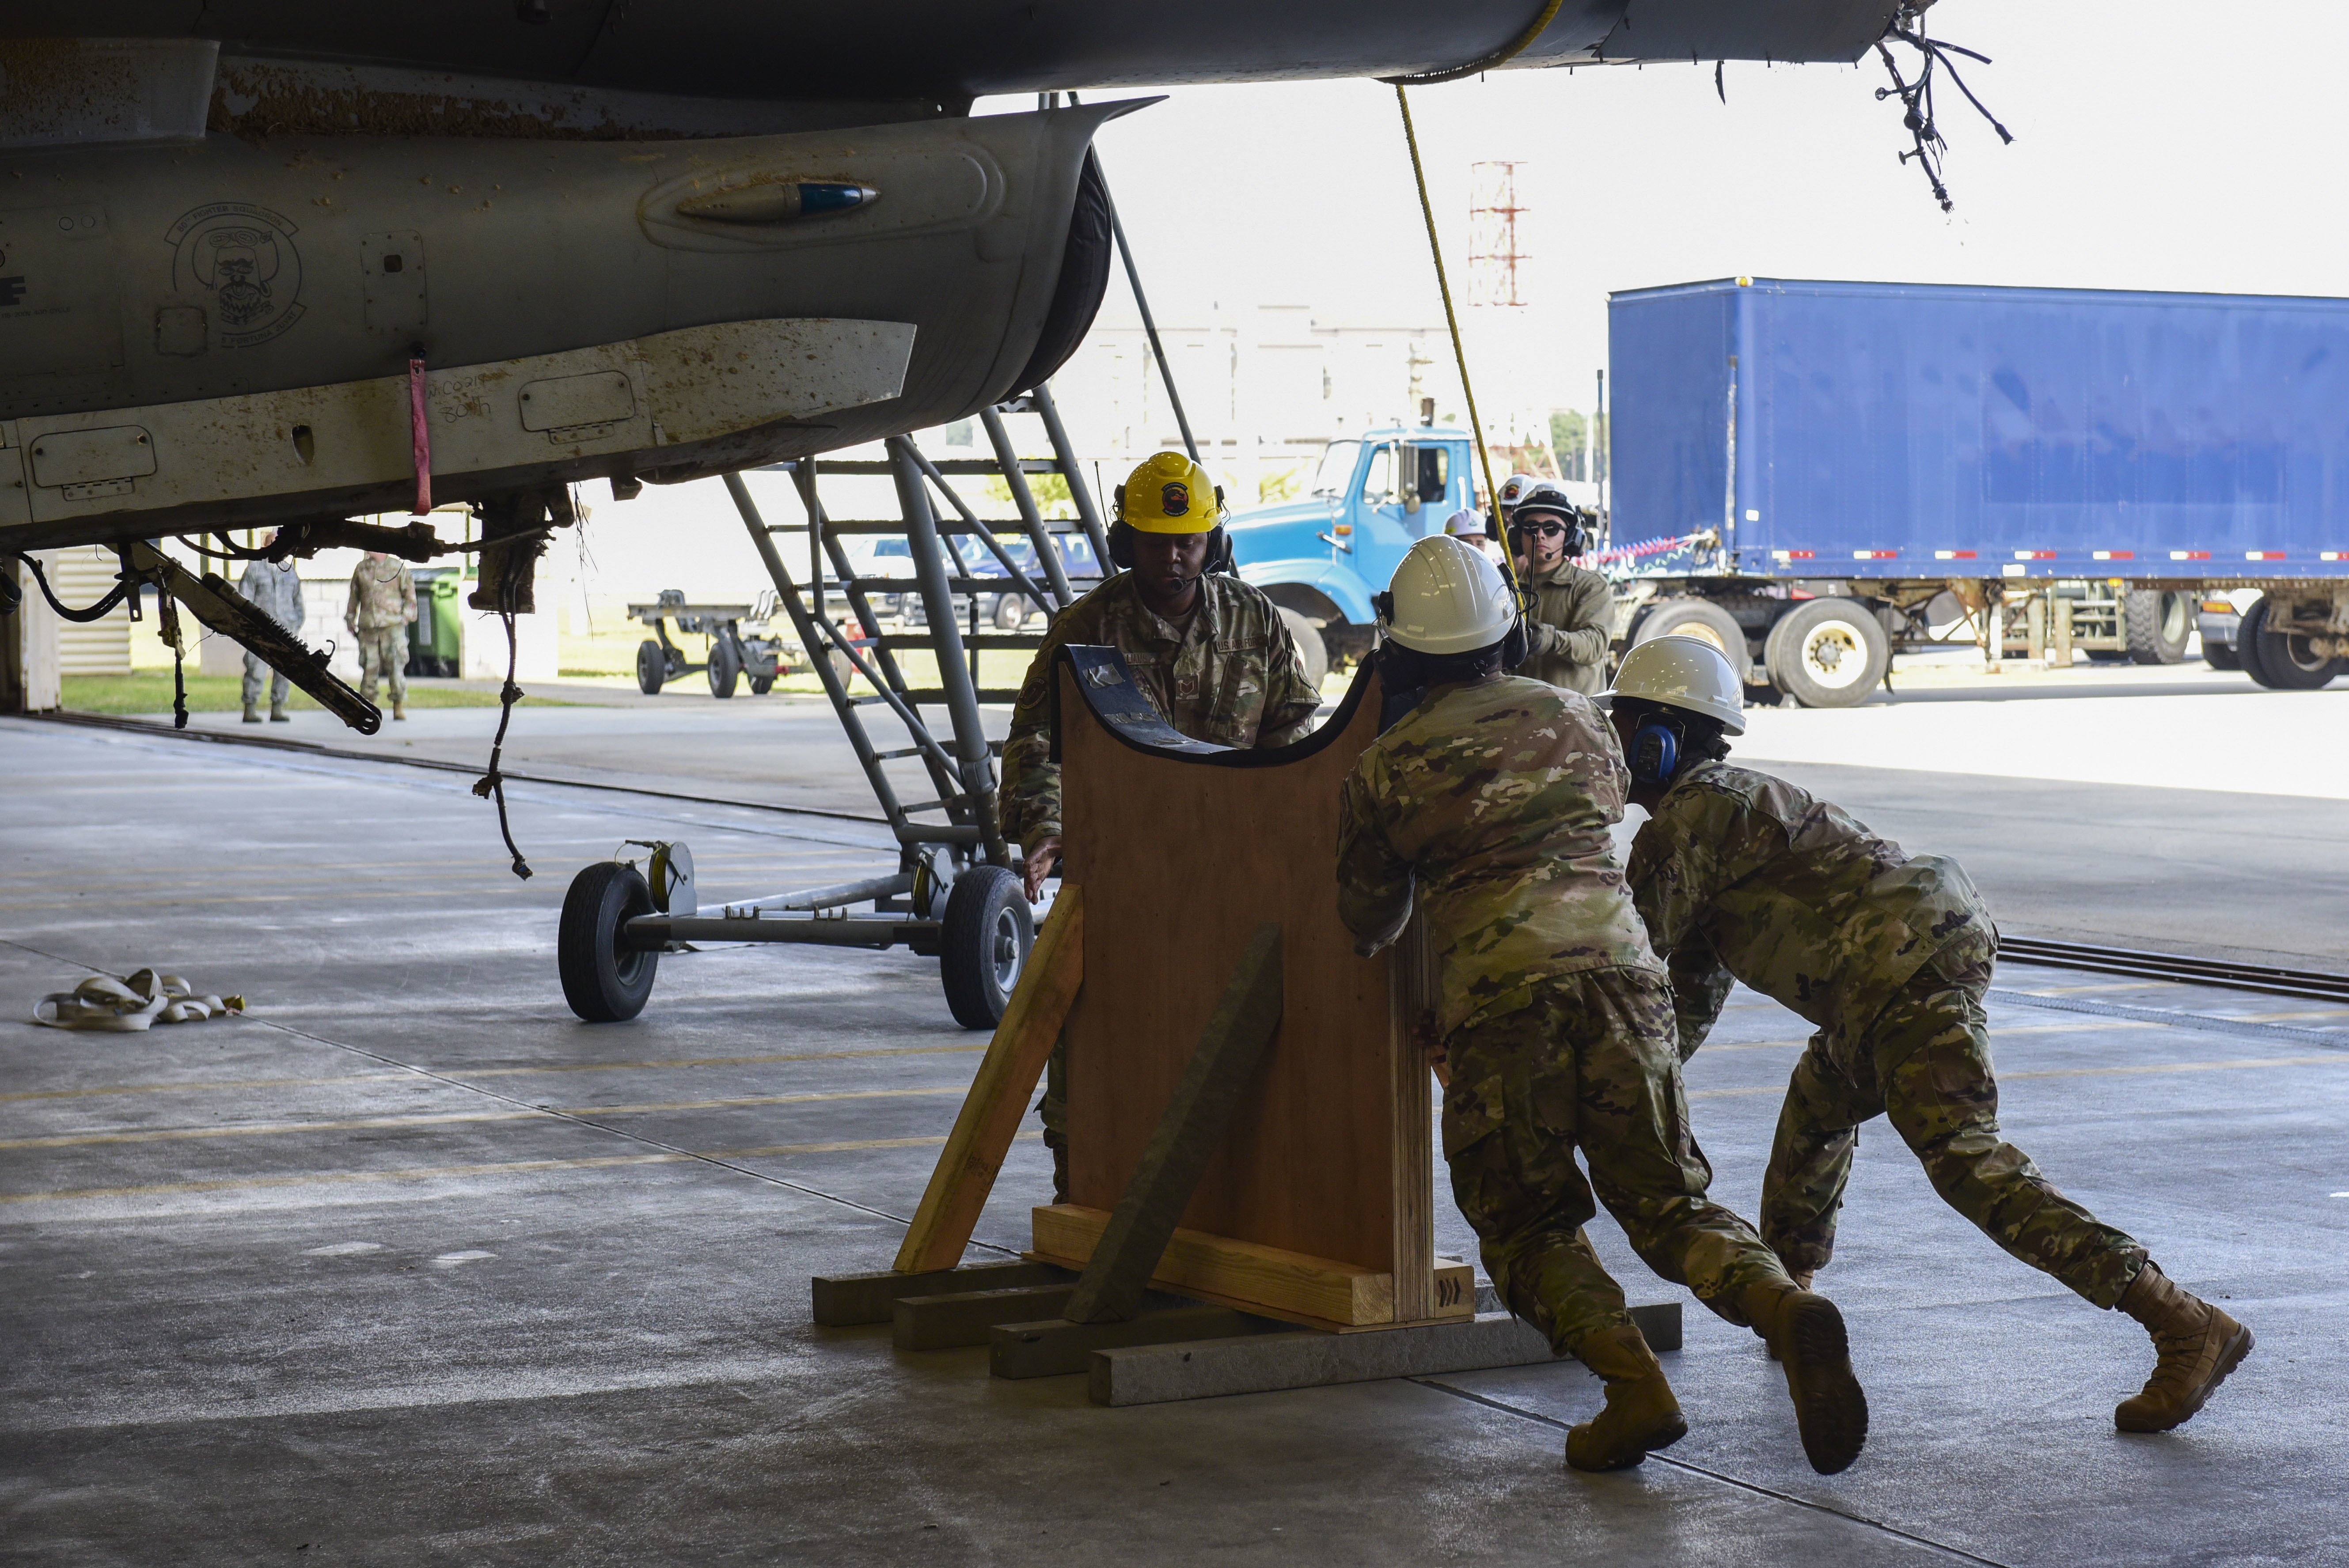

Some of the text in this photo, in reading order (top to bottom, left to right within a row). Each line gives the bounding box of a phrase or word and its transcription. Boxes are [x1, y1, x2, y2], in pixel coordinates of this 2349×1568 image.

[192, 205, 229, 220] FIGHTER
[232, 206, 283, 226] SQUADRON
[231, 330, 273, 344] FORTUNA
[276, 311, 296, 332] JUVAT
[1218, 641, 1230, 650] U.S.
[1232, 639, 1243, 649] AIR
